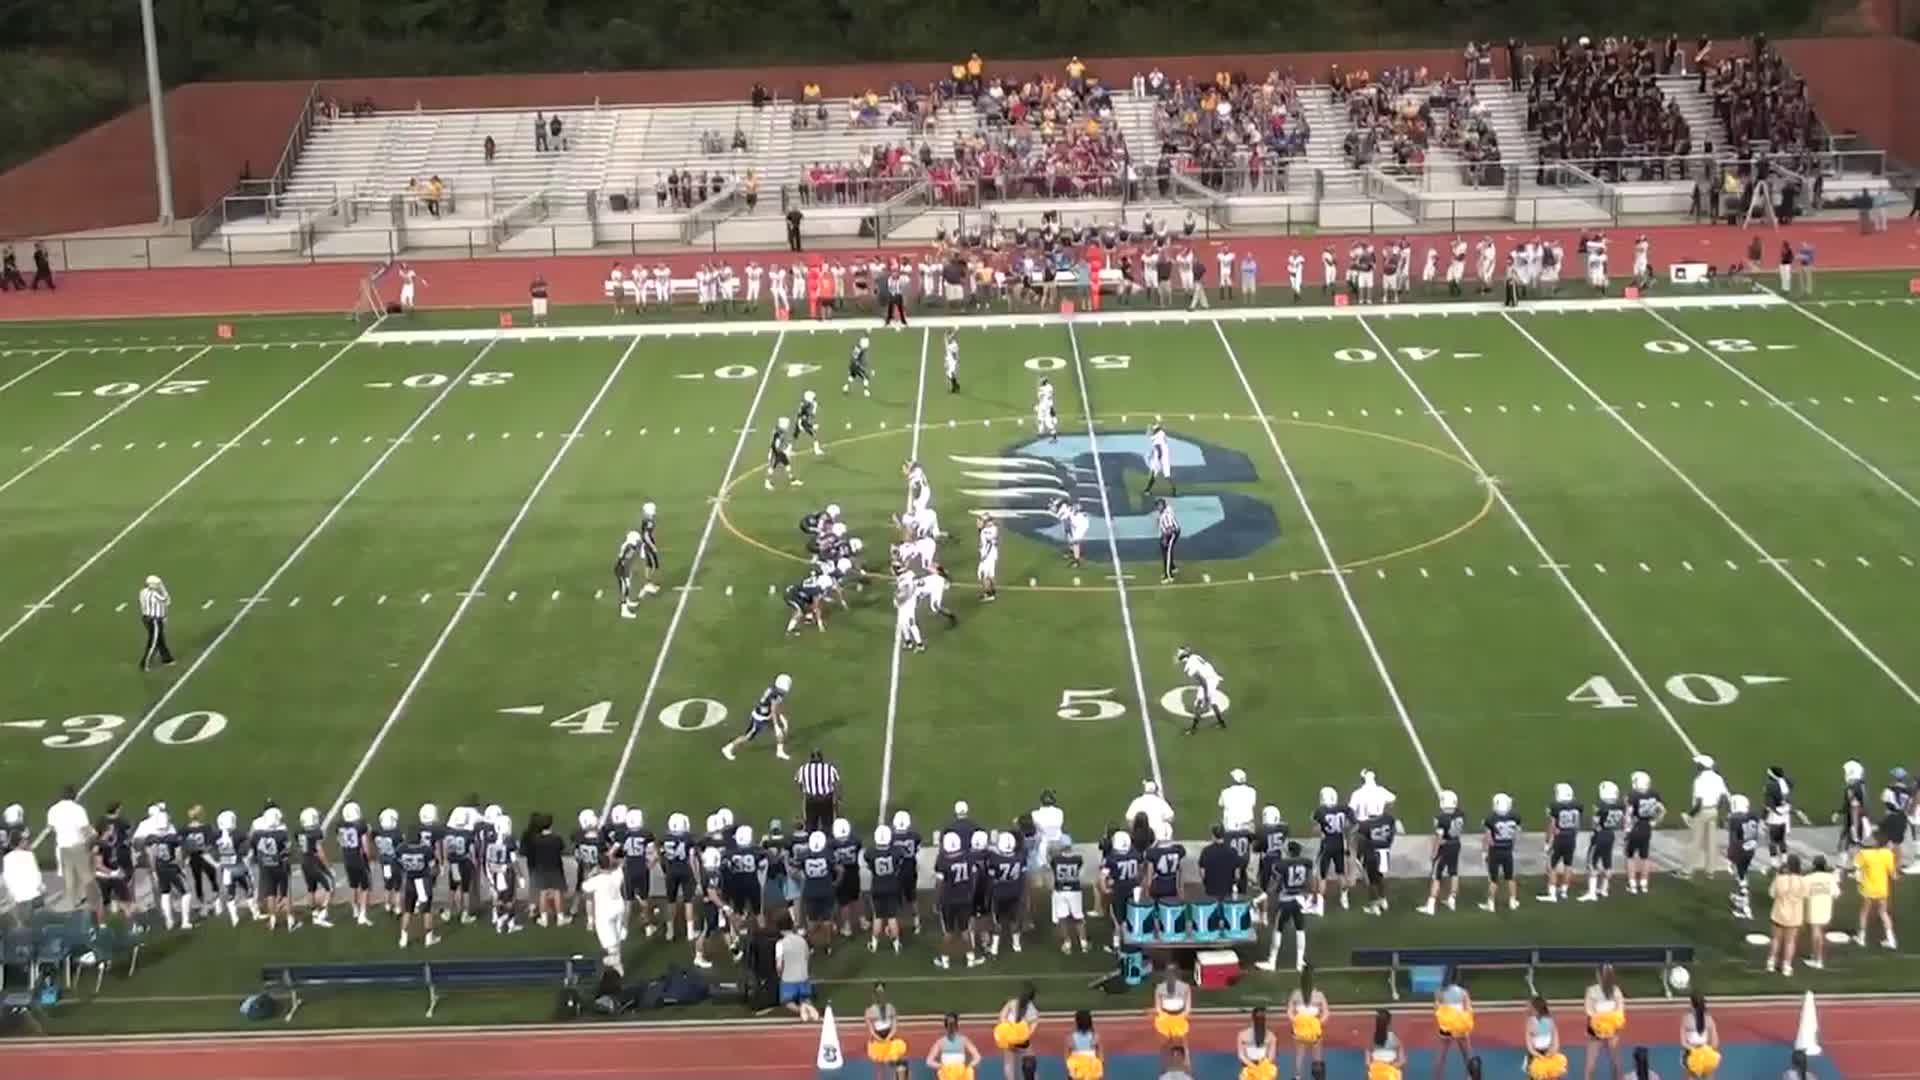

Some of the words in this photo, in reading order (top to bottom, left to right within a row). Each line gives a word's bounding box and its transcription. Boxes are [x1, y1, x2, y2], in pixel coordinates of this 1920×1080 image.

[1565, 671, 1740, 708] 40
[1056, 686, 1231, 721] 50
[550, 698, 728, 734] 40
[42, 710, 228, 748] 30
[1325, 812, 1345, 832] 30
[624, 837, 645, 856] 45
[664, 841, 687, 860] 54
[1267, 833, 1282, 851] 15
[951, 862, 969, 882] 71
[999, 862, 1021, 880] 74
[1117, 859, 1138, 880] 70
[1157, 853, 1179, 874] 47
